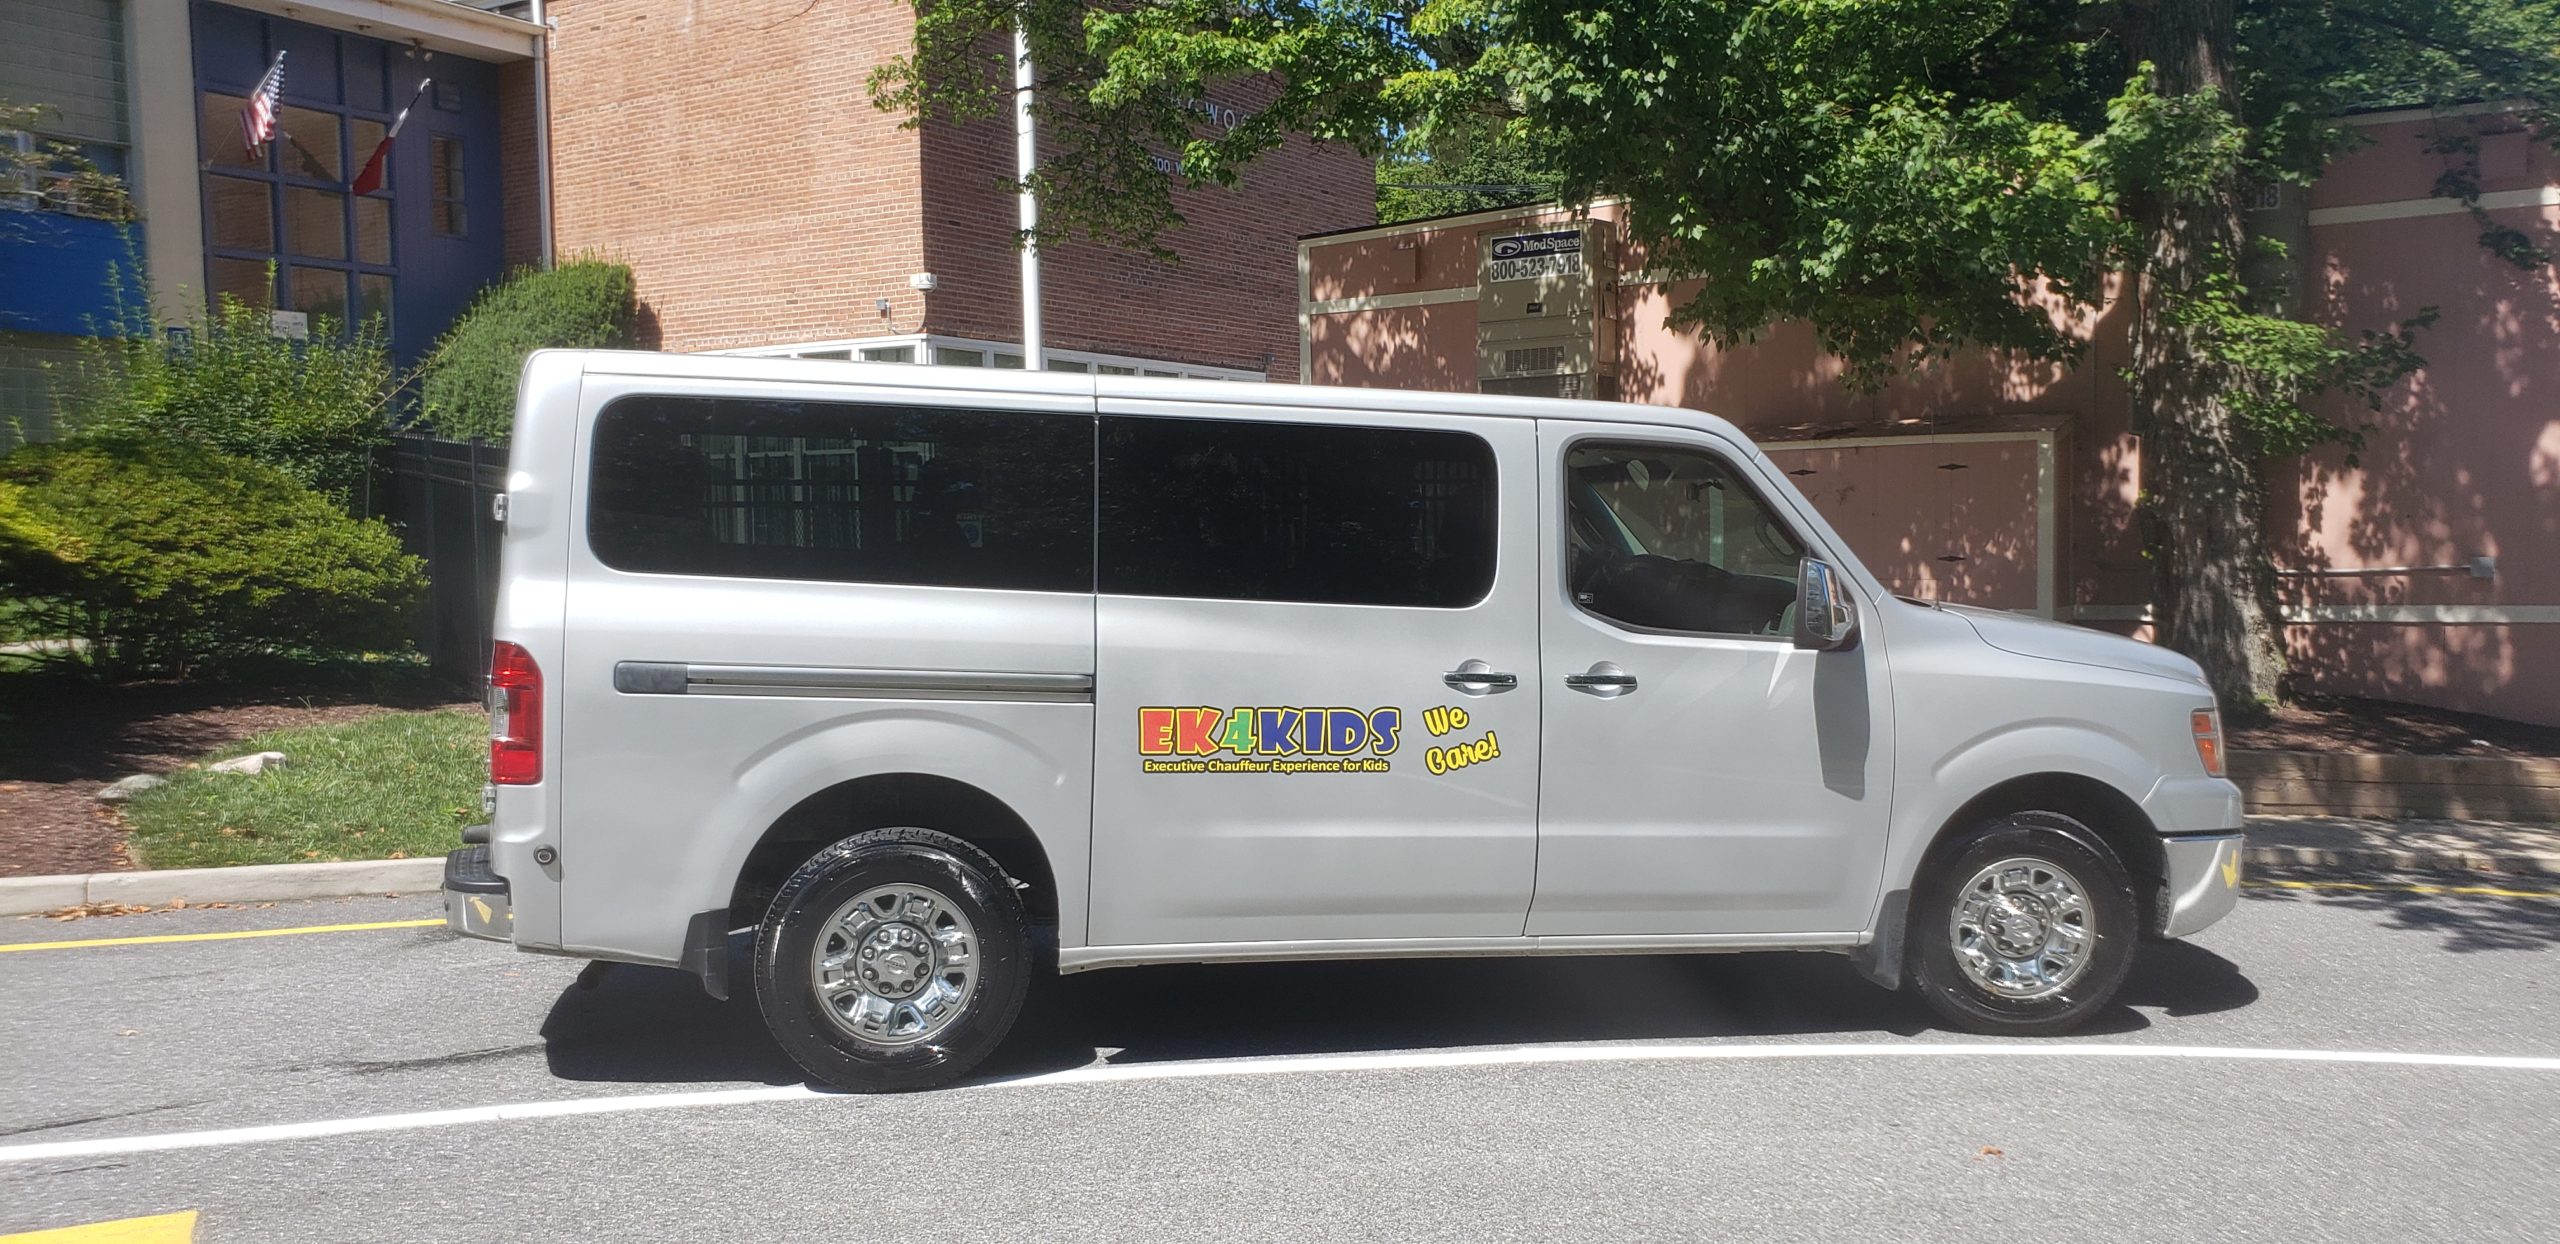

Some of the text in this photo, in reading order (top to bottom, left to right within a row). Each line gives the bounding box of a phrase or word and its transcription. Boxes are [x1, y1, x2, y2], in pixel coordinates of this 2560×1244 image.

[1523, 237, 1580, 251] ModSpace
[1492, 254, 1580, 280] 800-523-7918
[1138, 706, 1401, 756] EK4KIDS
[1422, 705, 1469, 737] We
[1143, 759, 1389, 774] Executive Chauffeur Experience for Kids
[1425, 730, 1501, 776] Care!
